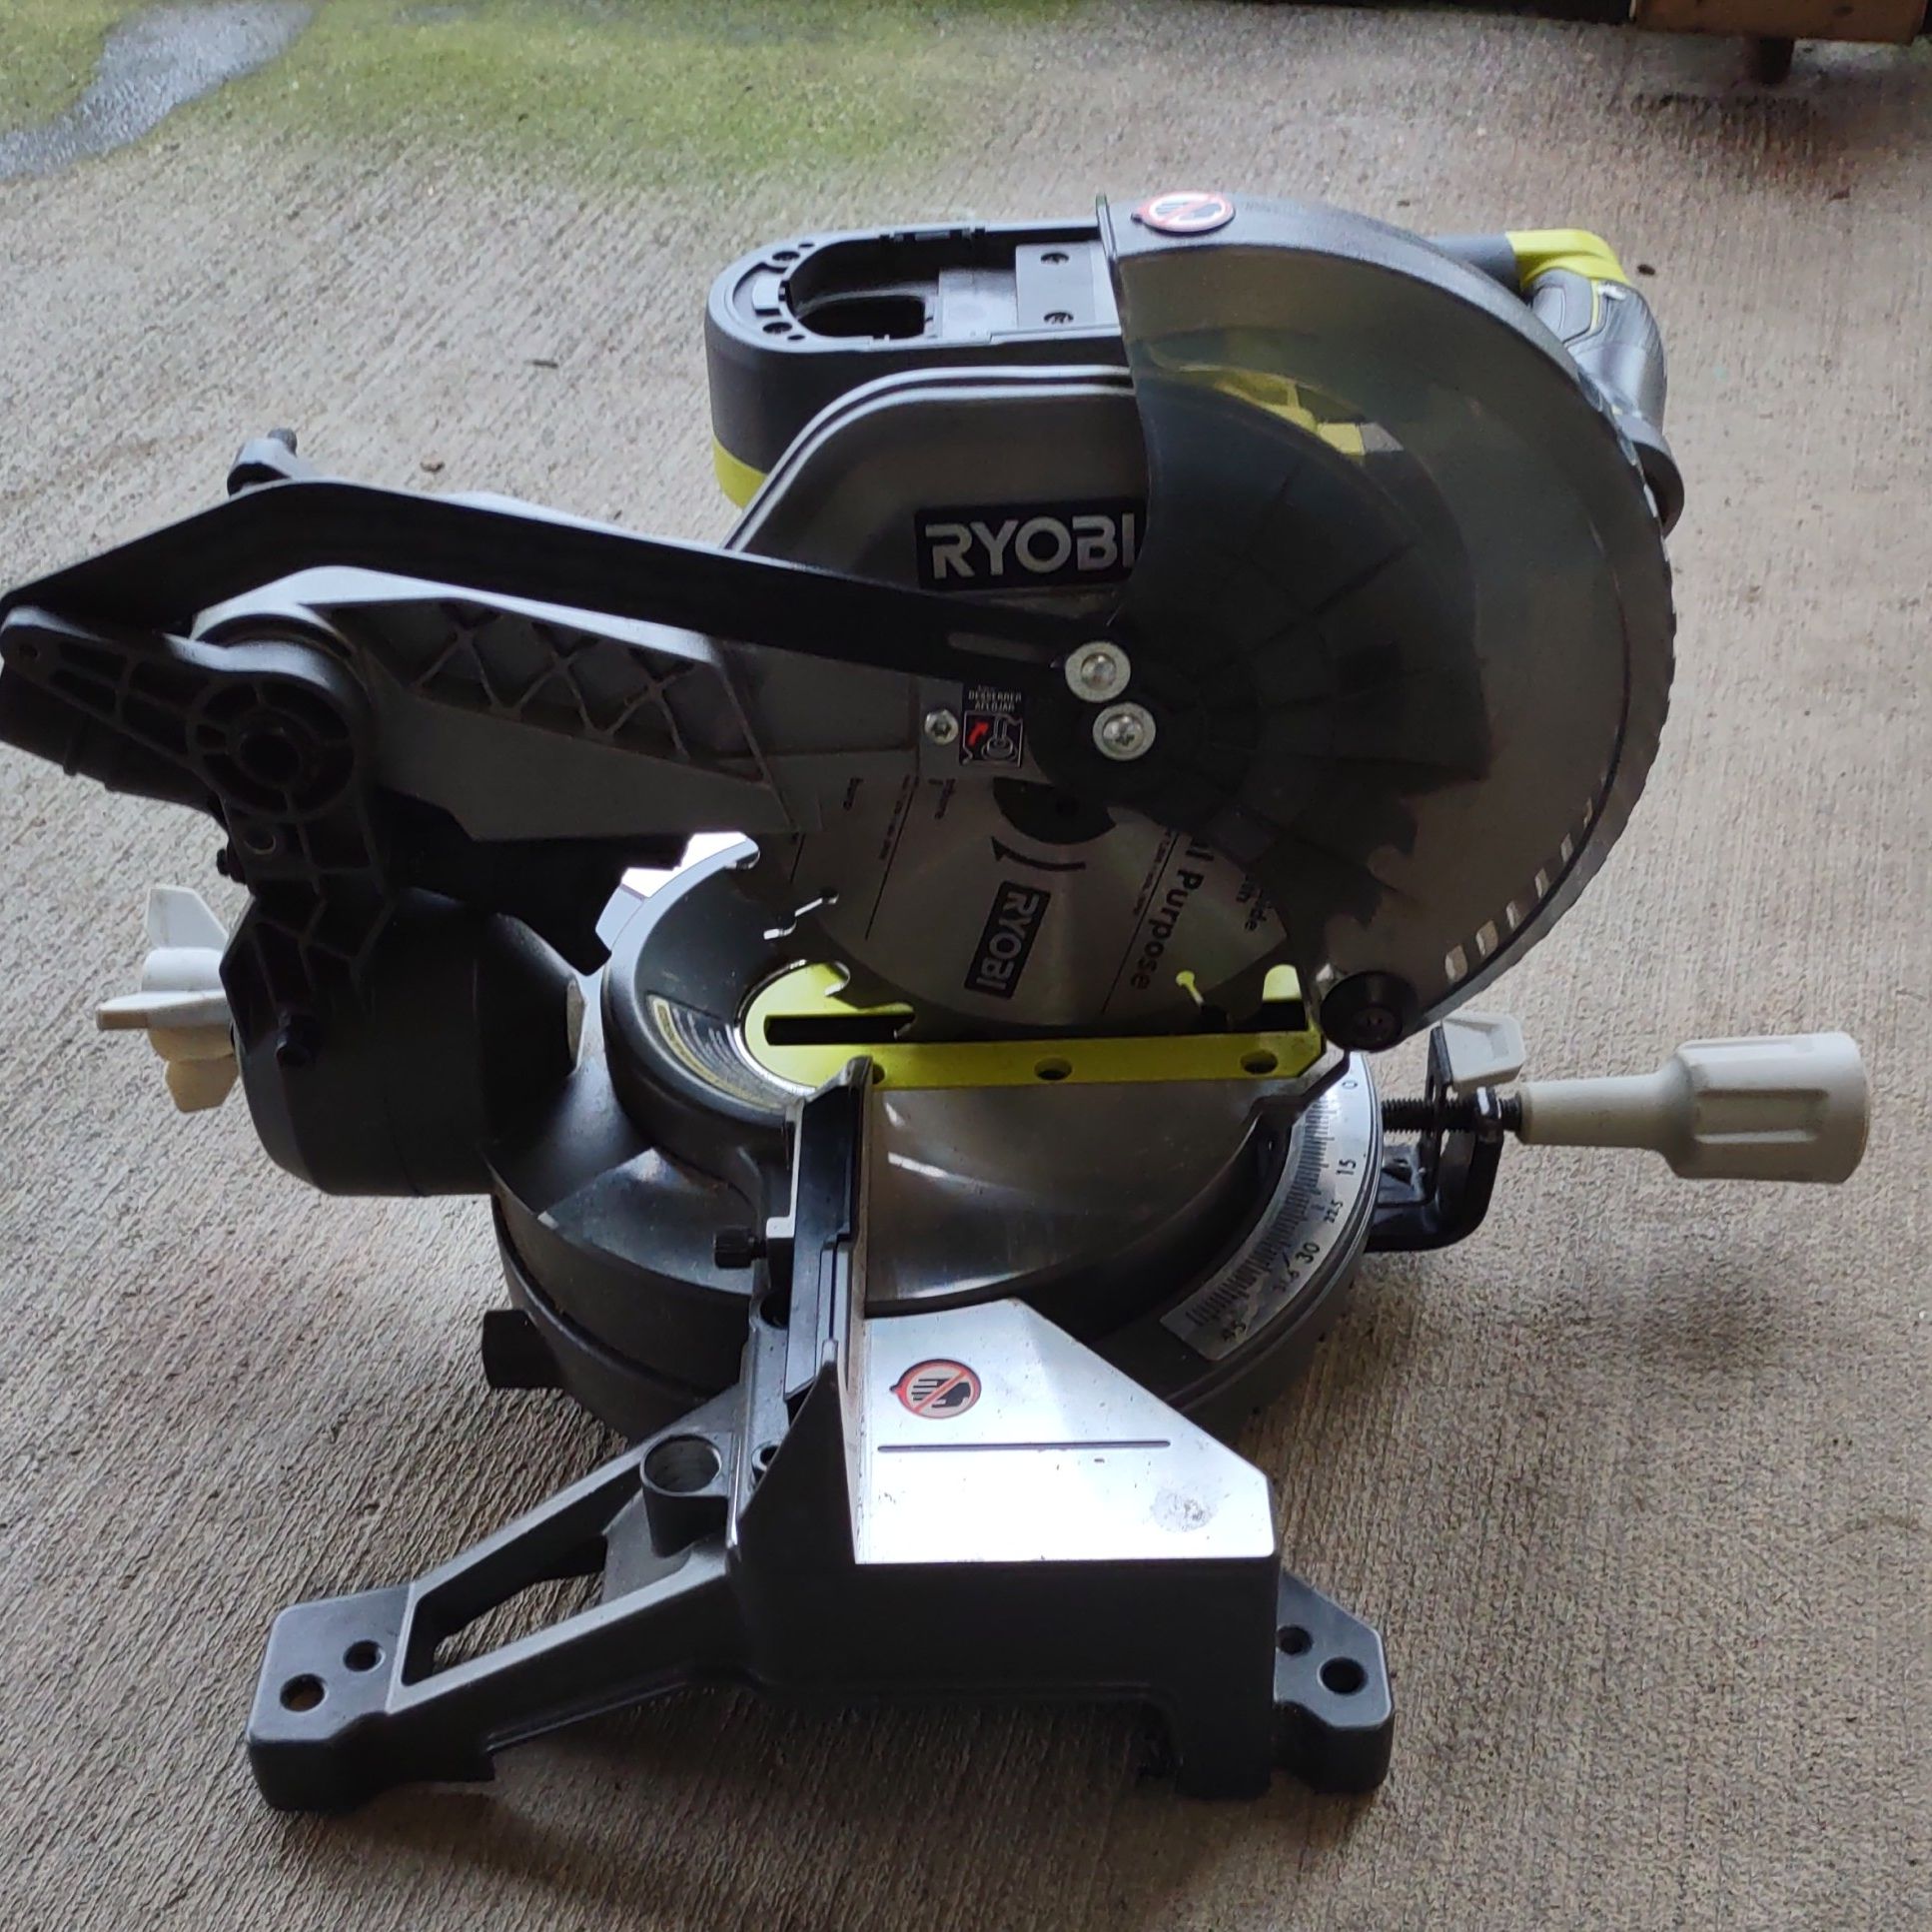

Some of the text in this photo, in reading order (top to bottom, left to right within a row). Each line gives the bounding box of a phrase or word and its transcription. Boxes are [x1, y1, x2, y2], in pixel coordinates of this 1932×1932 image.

[925, 512, 1135, 579] RYOBI
[976, 891, 1040, 990] RYOBI
[1131, 869, 1205, 990] Purpose
[1337, 1158, 1357, 1176] 15
[1296, 1241, 1321, 1265] 30
